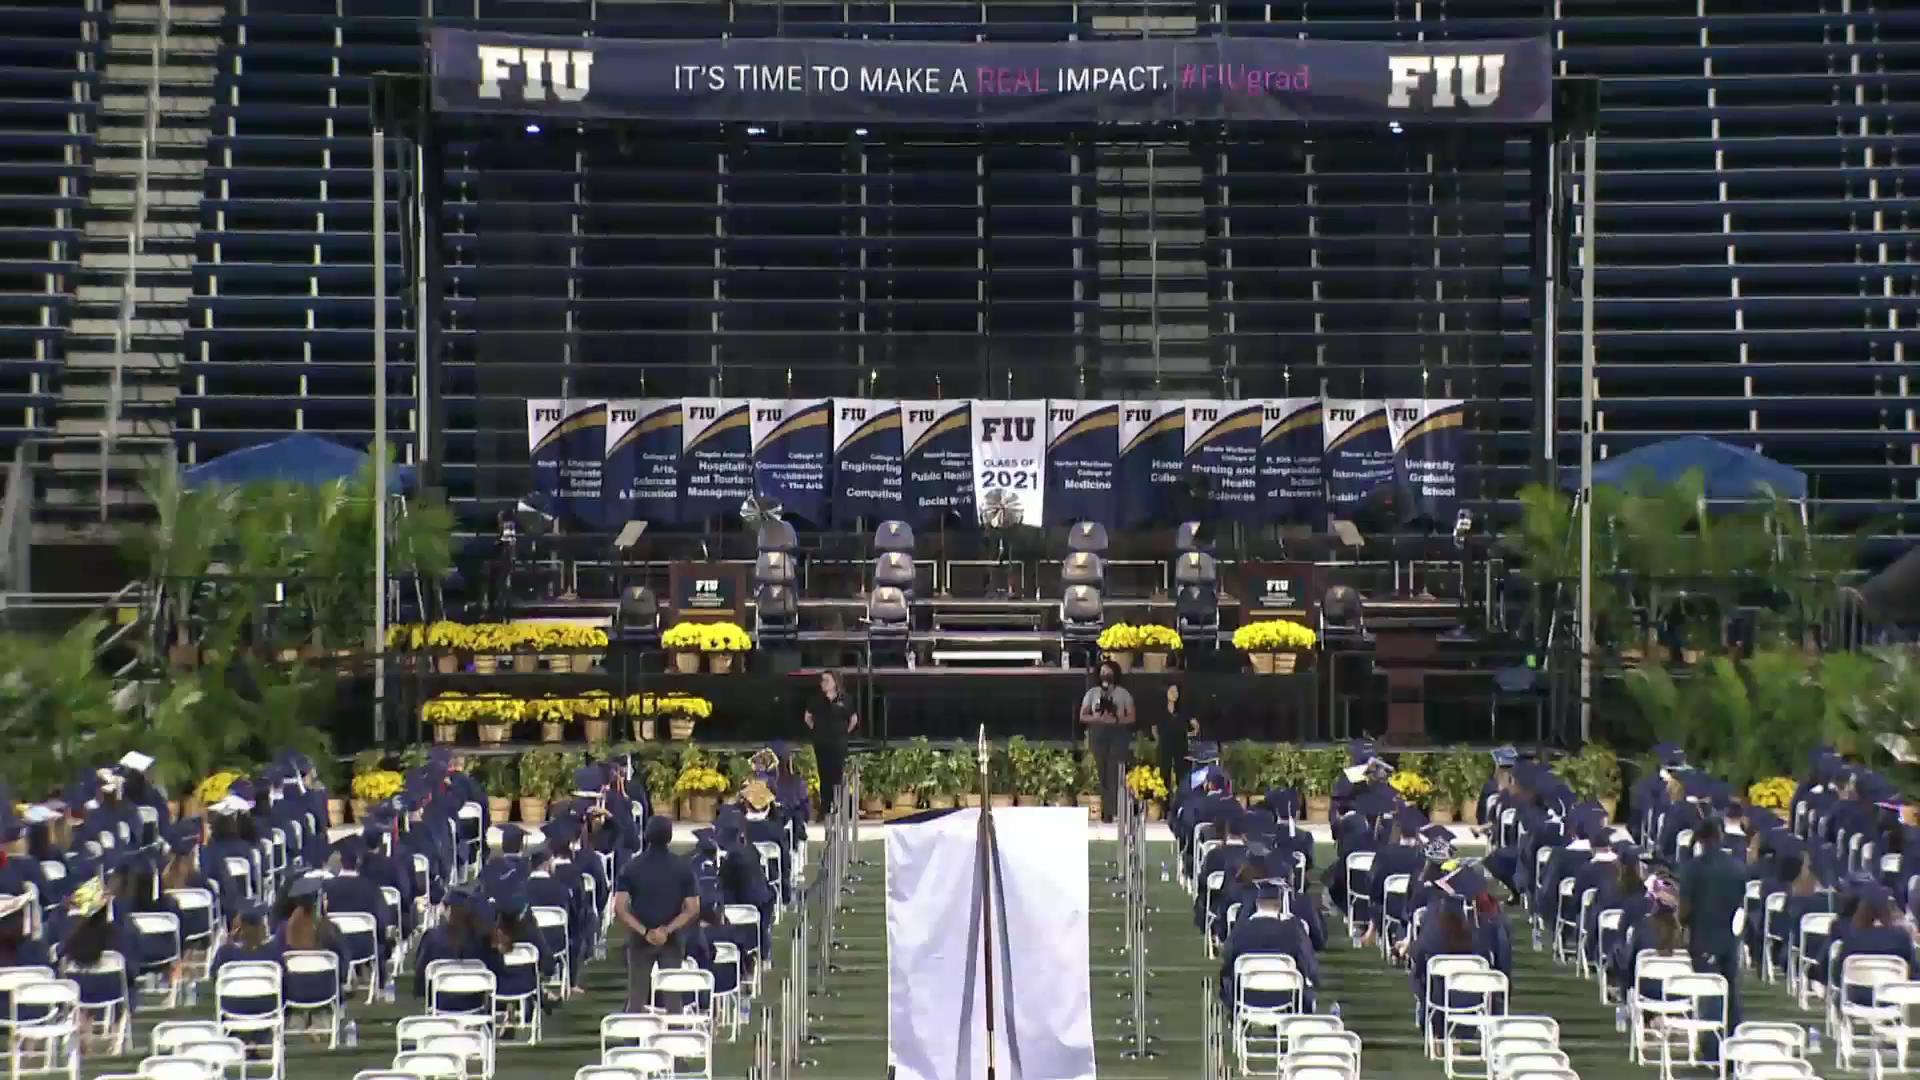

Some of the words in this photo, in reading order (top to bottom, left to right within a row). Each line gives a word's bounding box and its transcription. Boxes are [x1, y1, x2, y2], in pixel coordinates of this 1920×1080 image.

[477, 44, 595, 102] FIU
[673, 64, 725, 91] IT'S
[733, 64, 801, 91] TIME
[812, 66, 850, 92] TO
[859, 67, 940, 93] MAKE
[948, 67, 969, 93] A
[976, 66, 1049, 94] REAL
[1057, 66, 1168, 93] IMPACT.
[1181, 63, 1310, 97] #FIUgrad
[1387, 53, 1506, 109] FIU
[535, 408, 561, 422] FIU
[611, 409, 636, 422] FIU
[689, 407, 716, 420] FIU
[756, 408, 782, 422] FIU
[841, 408, 866, 421] FIU
[909, 410, 934, 423] FIU
[1049, 408, 1075, 422] FIU
[1125, 408, 1151, 422] FIU
[1192, 408, 1218, 421] FIU
[1264, 407, 1281, 420] IU
[1329, 408, 1356, 422] FIU
[1392, 407, 1418, 421] FIU
[981, 417, 1036, 442] FIU
[841, 461, 901, 475] Engineering
[983, 459, 1018, 468] CLASS
[1021, 459, 1035, 467] OF
[1236, 466, 1255, 474] and
[1405, 458, 1455, 471] University
[691, 474, 710, 483] and
[912, 472, 941, 481] Public
[981, 470, 1038, 490] 2021
[1222, 478, 1255, 488] Health
[1409, 473, 1455, 483] Graduate
[1065, 480, 1111, 489] Medicine
[1422, 486, 1455, 496] School
[847, 488, 901, 501] Computing
[919, 496, 948, 506] Social
[695, 579, 719, 592] FIU
[1266, 579, 1289, 592] FIU
